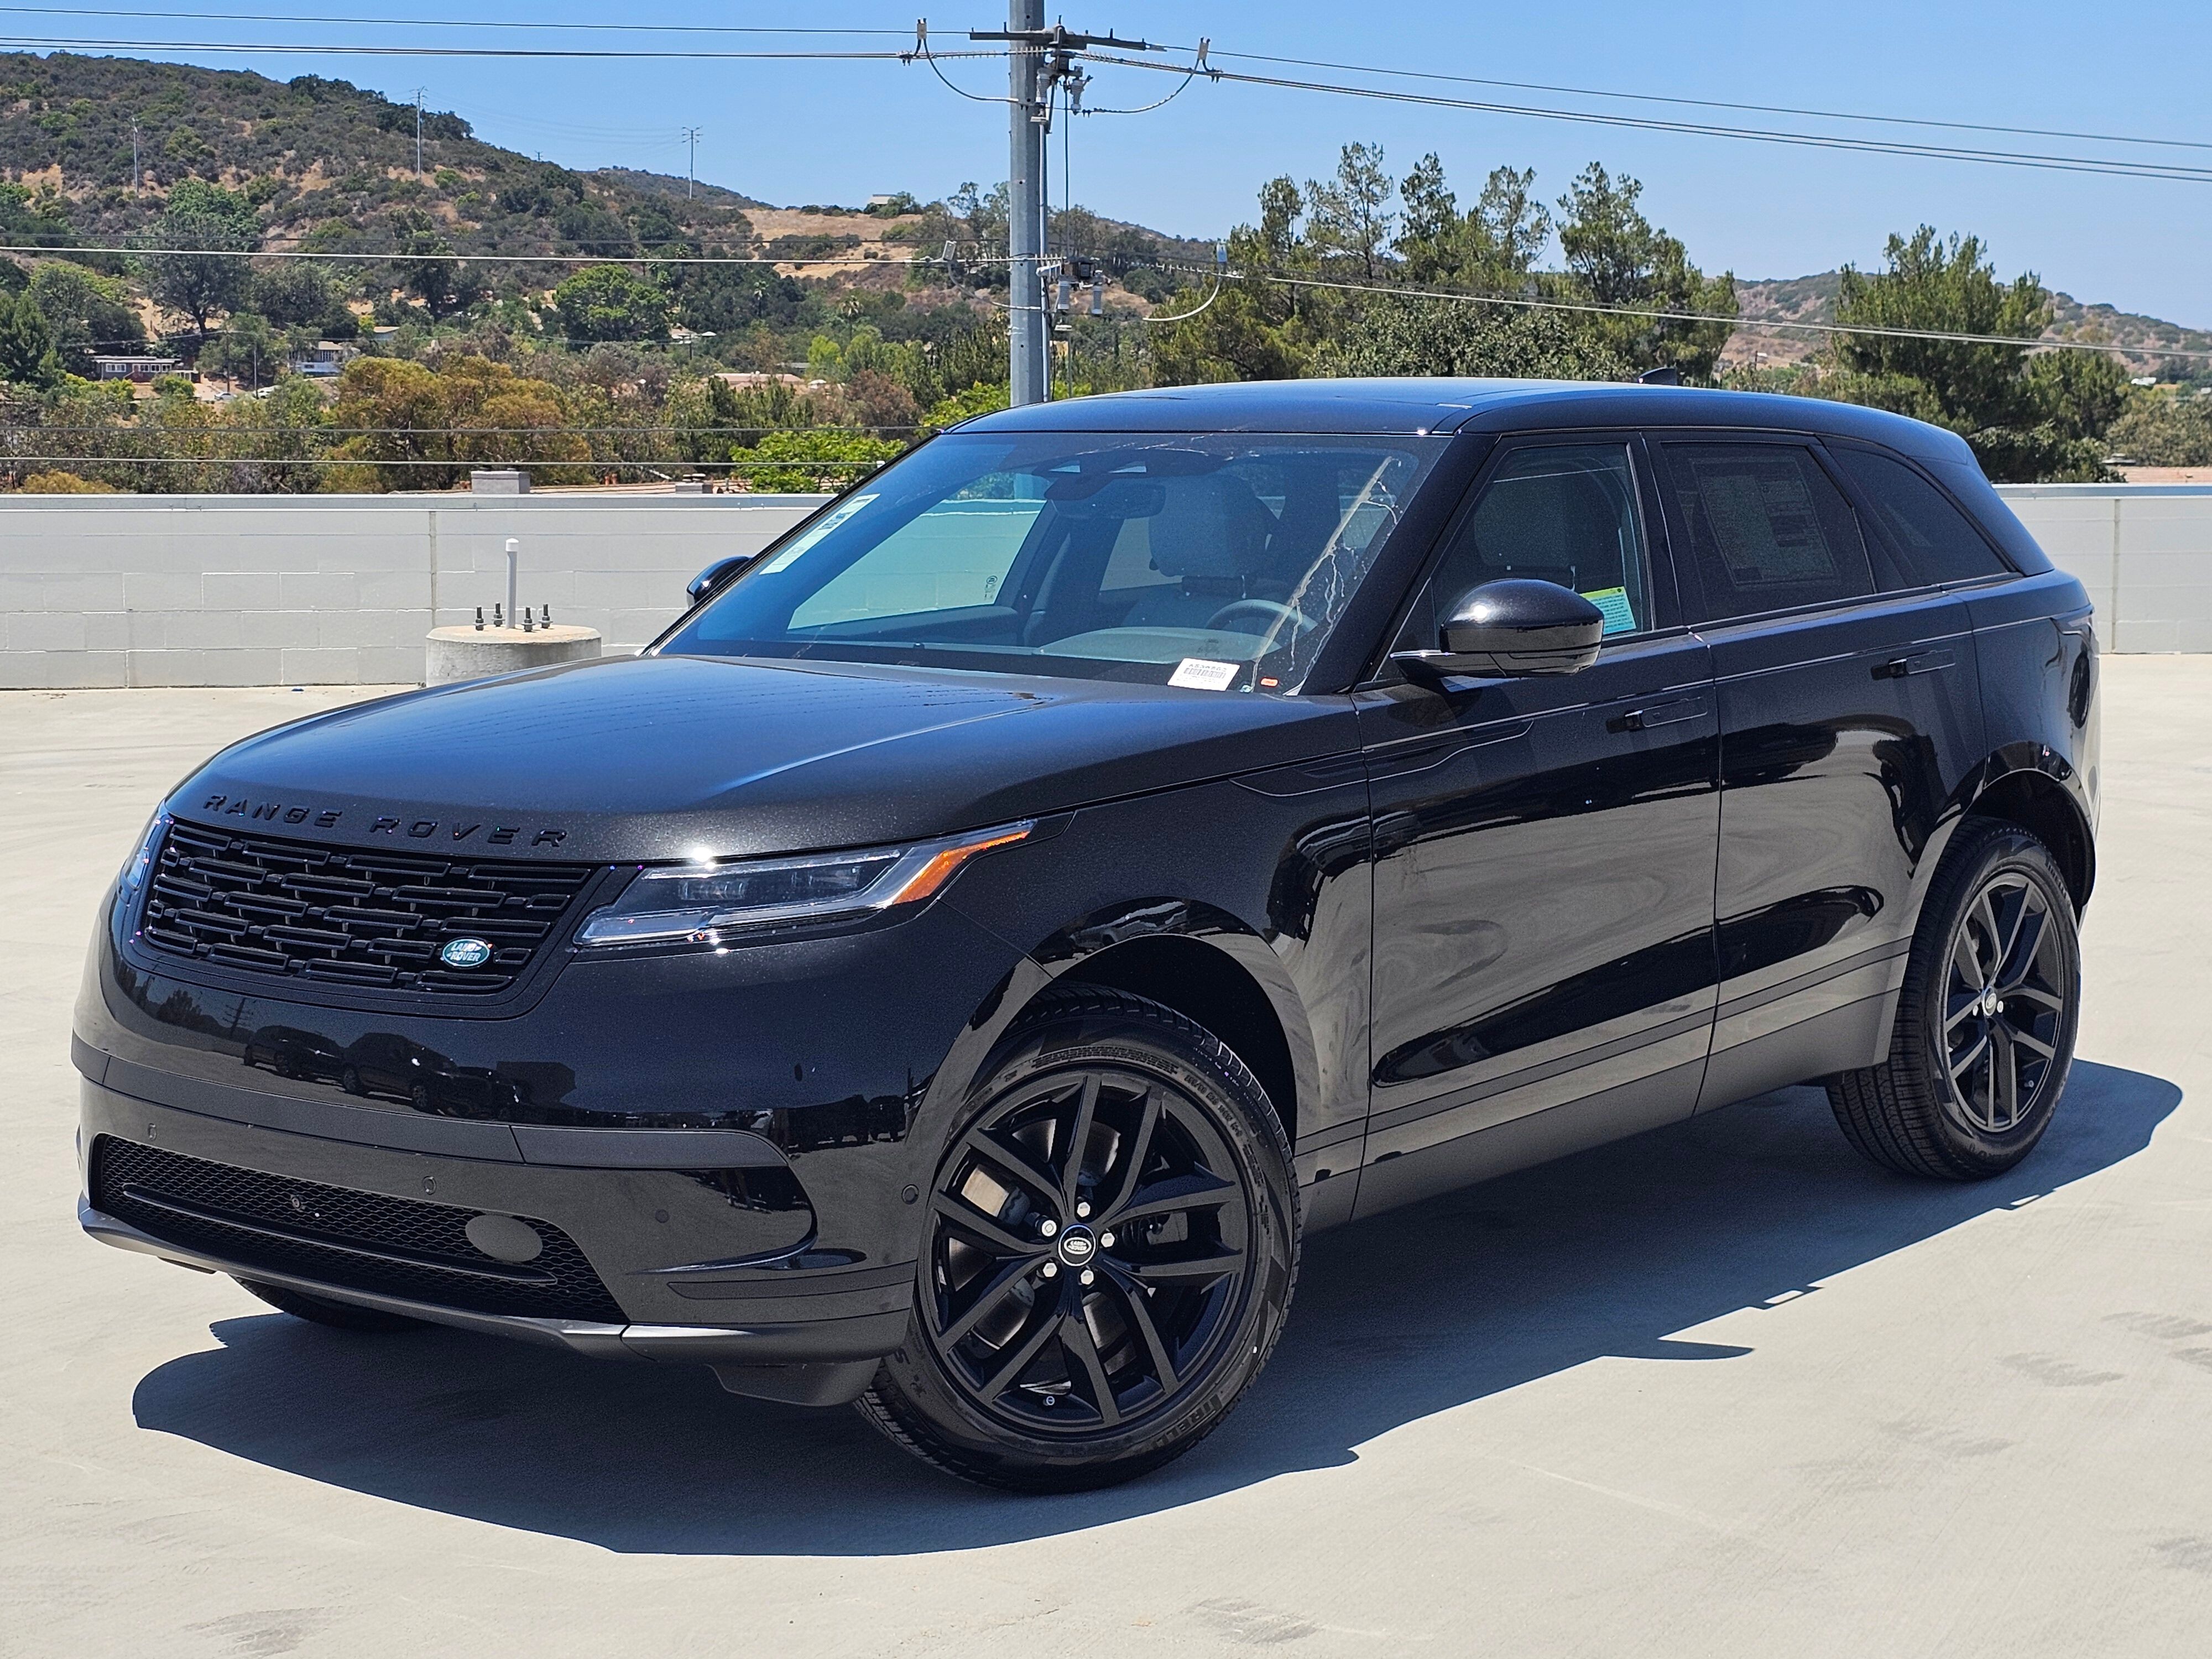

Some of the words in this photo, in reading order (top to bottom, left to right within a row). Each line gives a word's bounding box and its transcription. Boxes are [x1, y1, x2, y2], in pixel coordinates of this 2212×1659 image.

[204, 795, 342, 828] RANGE
[369, 816, 568, 848] ROVER
[451, 942, 477, 952] LAND
[450, 951, 481, 962] ROVER
